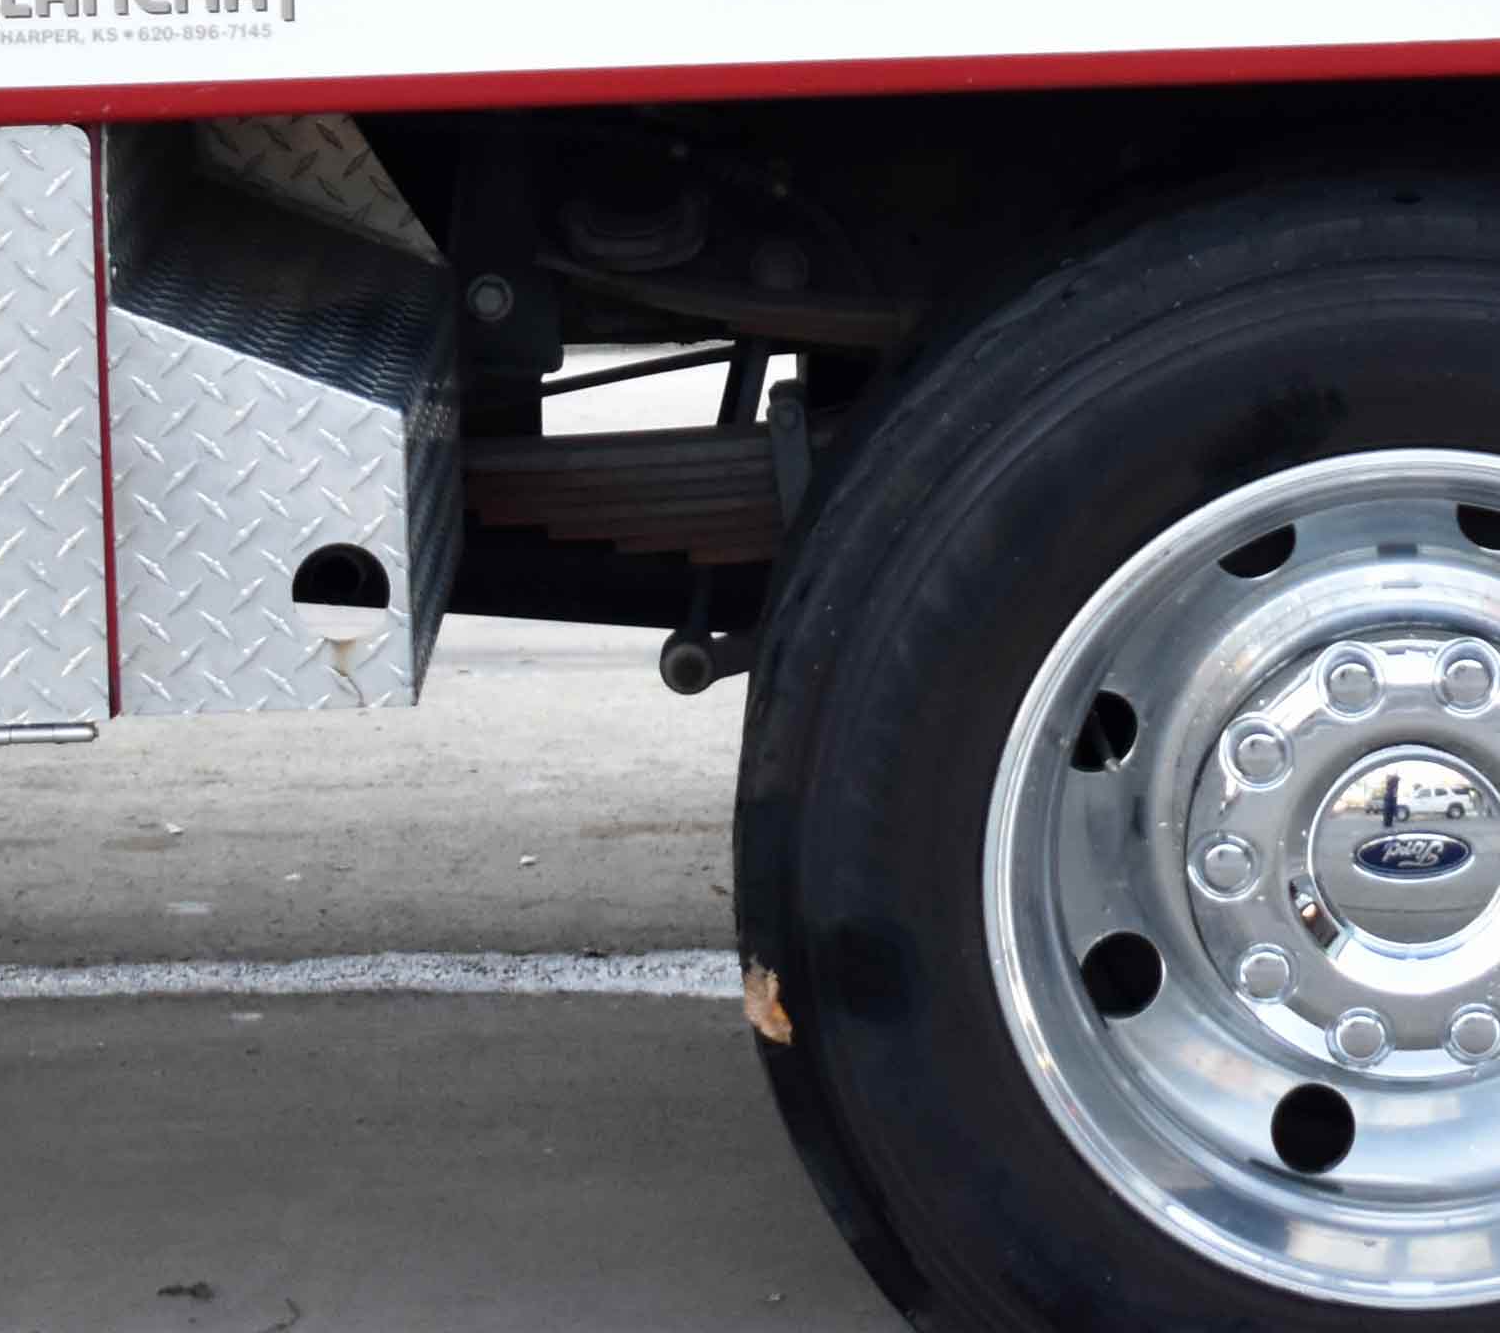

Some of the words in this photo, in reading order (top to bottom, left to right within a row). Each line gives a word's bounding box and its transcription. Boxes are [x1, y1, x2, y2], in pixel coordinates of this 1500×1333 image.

[0, 27, 85, 46] HARPER,
[91, 27, 118, 44] KS
[137, 22, 273, 43] 620-896-7145
[1381, 839, 1444, 868] Ford
